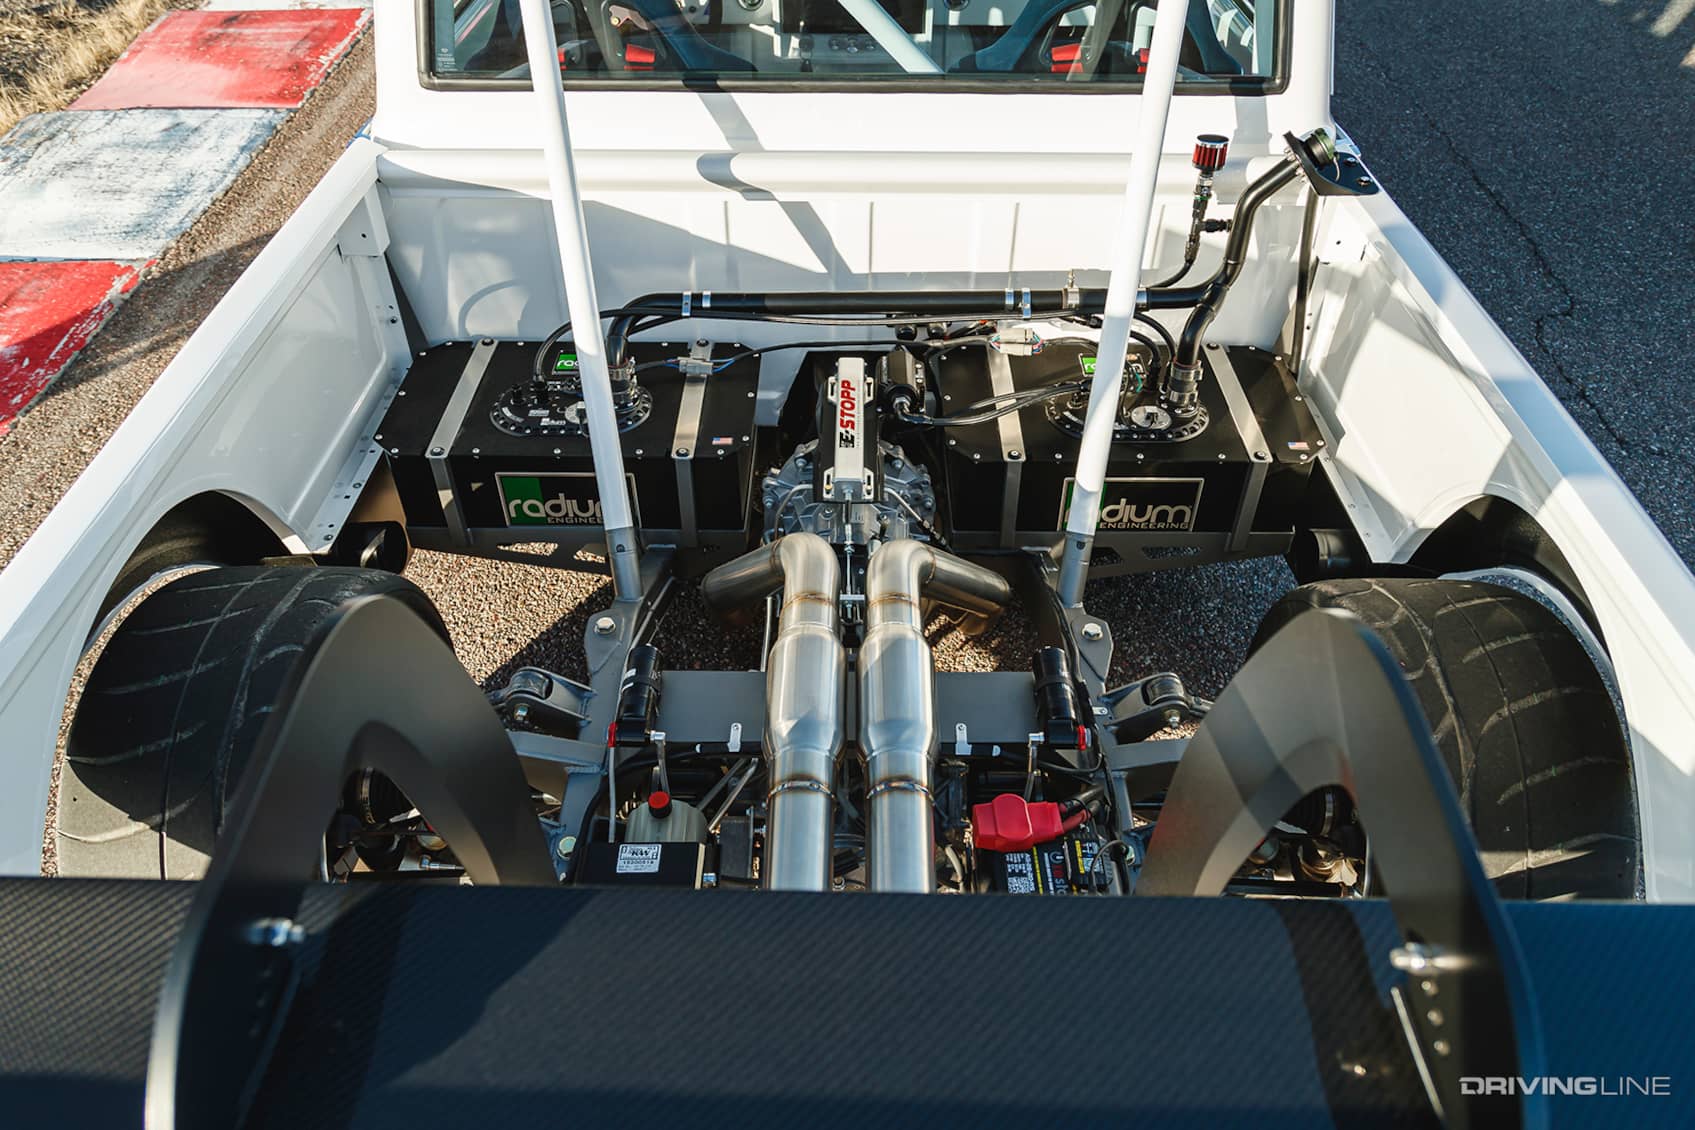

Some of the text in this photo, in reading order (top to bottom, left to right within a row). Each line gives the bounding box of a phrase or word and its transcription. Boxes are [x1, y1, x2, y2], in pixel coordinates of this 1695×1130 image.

[508, 492, 603, 518] radiu
[1065, 497, 1192, 523] dium
[547, 516, 603, 524] ENGINEE
